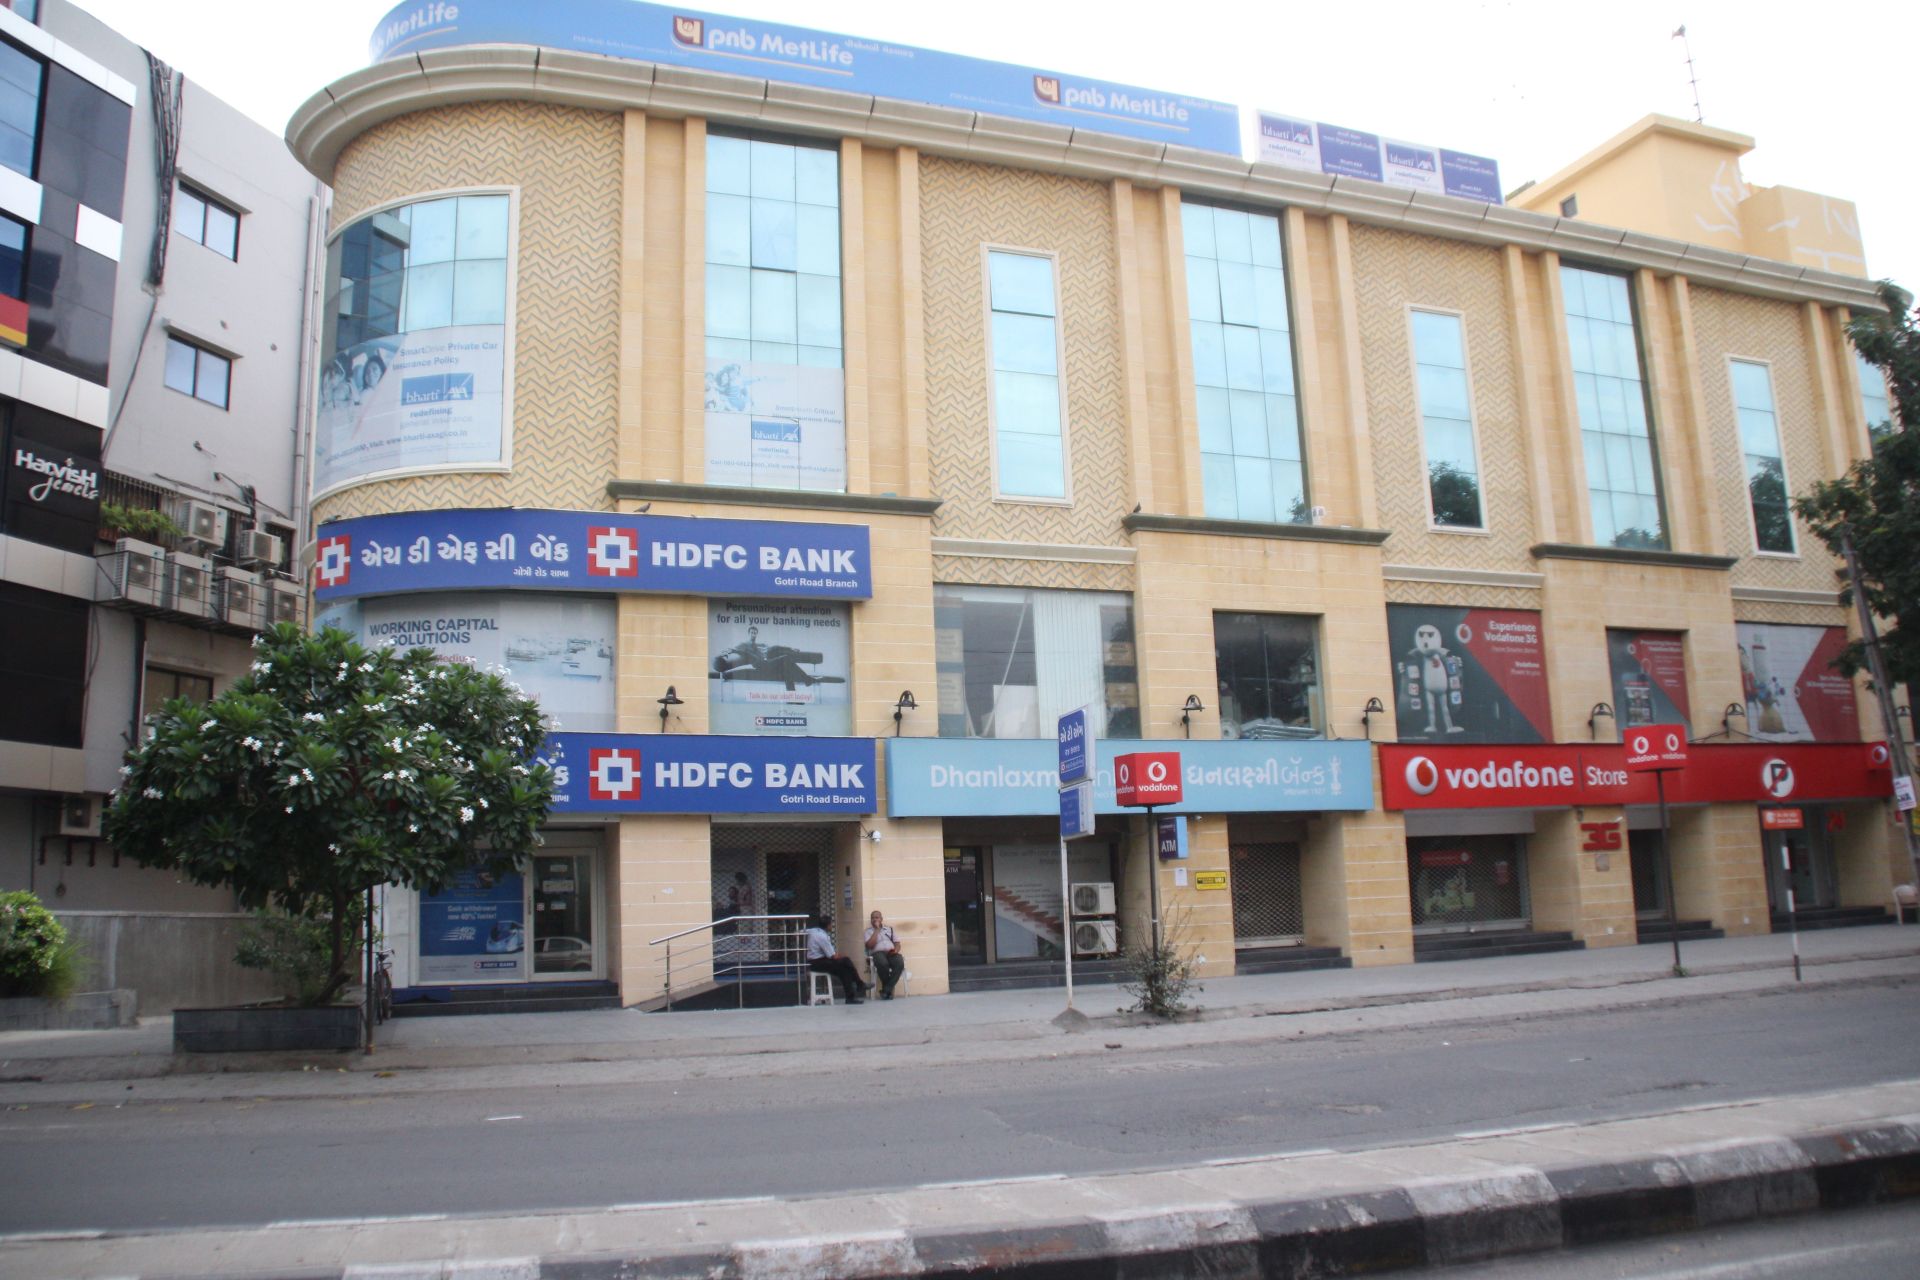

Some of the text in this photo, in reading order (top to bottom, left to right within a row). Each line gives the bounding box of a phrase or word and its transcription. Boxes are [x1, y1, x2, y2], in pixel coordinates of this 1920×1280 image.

[708, 28, 756, 50] pnb
[760, 33, 854, 65] MetLife
[1064, 87, 1106, 108] pnb
[1109, 92, 1189, 121] MetLife
[448, 343, 480, 352] Private
[482, 342, 498, 350] Car
[434, 356, 459, 366] Policy
[406, 390, 440, 403] bharti
[361, 540, 401, 567] એચ
[407, 535, 431, 565] ડી
[437, 533, 477, 565] એફ
[485, 533, 515, 561] સી
[651, 541, 857, 573] HDFC BANK
[774, 576, 858, 588] Gotri Road Branch
[726, 602, 832, 615] Personalised attention
[370, 618, 499, 636] WORKING CAPITAL
[717, 614, 841, 628] for all your banking needs
[1488, 620, 1537, 633] Experience
[391, 631, 471, 645] SOLUTIONS
[1484, 631, 1525, 643] Vodafone
[1627, 753, 1659, 763] vodafone
[655, 762, 864, 788] HDFC BANK
[930, 764, 1059, 788] Dhanlaxm
[1444, 761, 1628, 789] vodafone Store
[1138, 783, 1178, 792] vodafone
[780, 794, 865, 804] Gotri Road Branch
[1580, 822, 1622, 851] 3G
[1161, 840, 1177, 853] ATM
